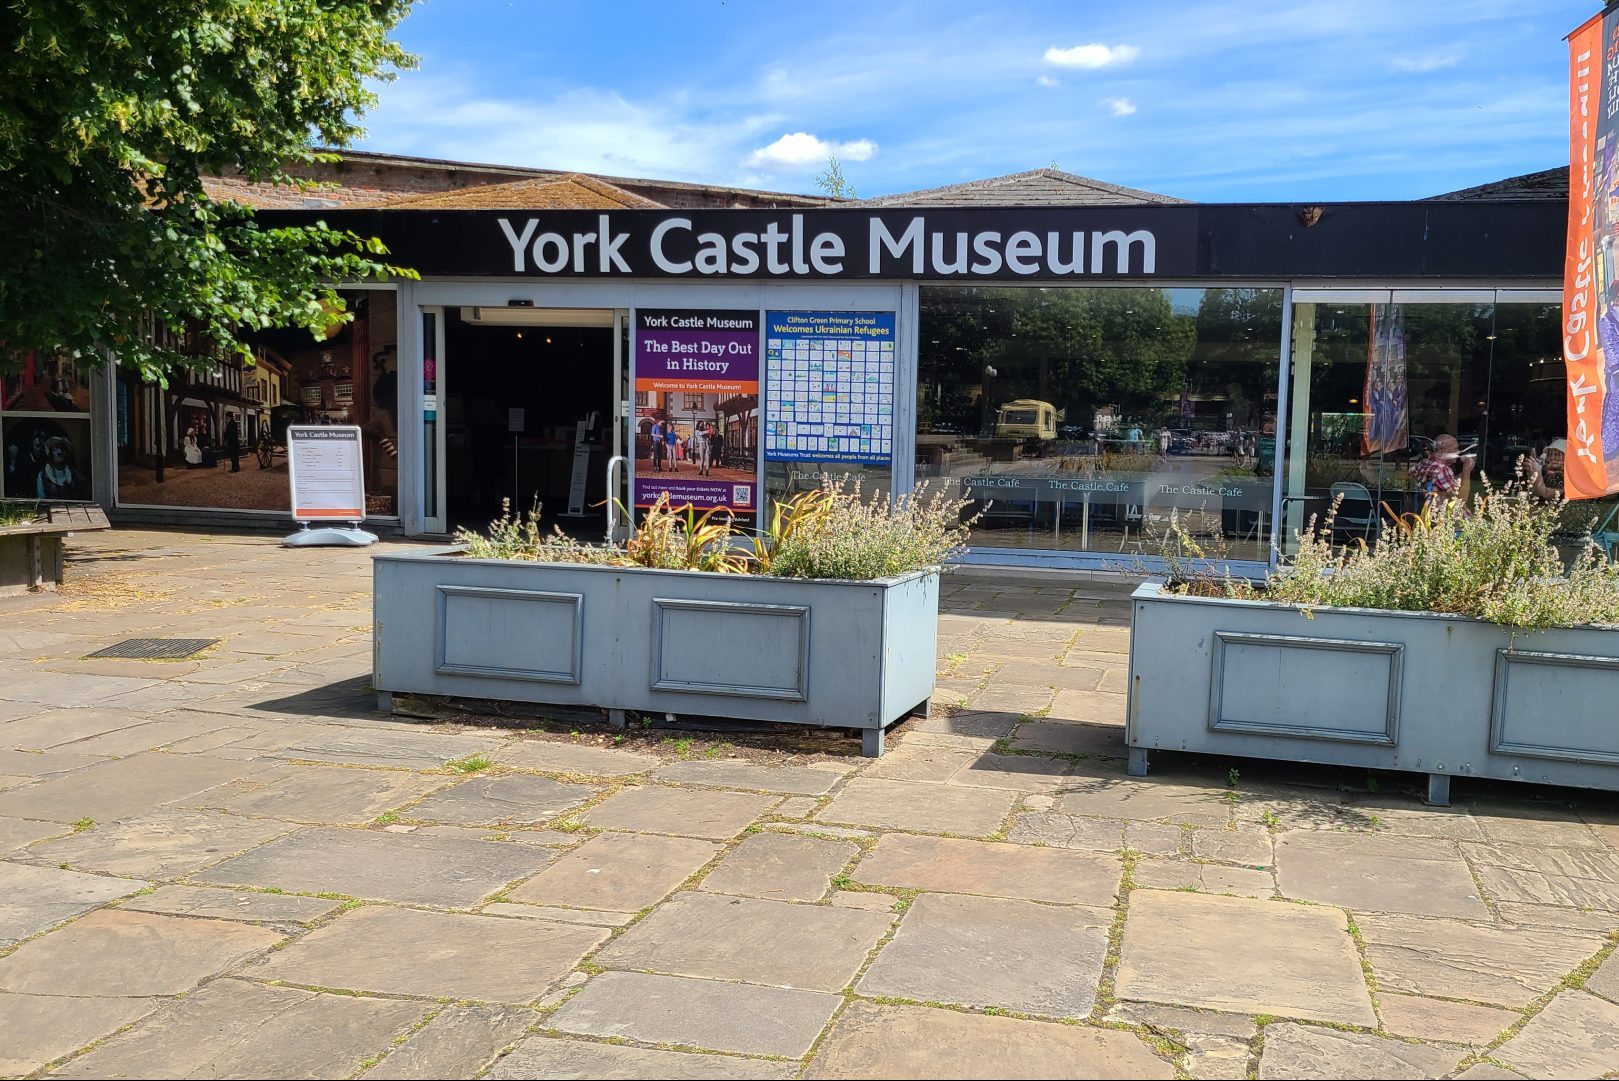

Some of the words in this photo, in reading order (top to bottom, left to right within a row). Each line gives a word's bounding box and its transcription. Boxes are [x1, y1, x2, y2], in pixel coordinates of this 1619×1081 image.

[497, 214, 633, 273] York
[649, 213, 846, 275] Castle
[869, 216, 1156, 275] Museum
[644, 316, 668, 328] York
[670, 316, 704, 328] Castle
[706, 317, 753, 329] Museum
[830, 317, 853, 326] Primary
[774, 324, 814, 333] Welcomes
[815, 325, 852, 334] Ukrainian
[854, 326, 890, 336] Refugees
[644, 340, 668, 352] The
[671, 341, 698, 353] Best
[701, 341, 726, 356] Day
[728, 342, 752, 354] Out
[666, 358, 680, 370] in
[682, 358, 729, 374] History
[792, 470, 809, 480] The
[812, 471, 842, 480] Castle
[942, 476, 960, 486] The
[964, 477, 994, 486] Castle
[998, 479, 1020, 488] Café
[1049, 480, 1067, 489] The
[1071, 481, 1102, 491] Castle
[1106, 483, 1129, 492] Café
[1160, 484, 1179, 494] The
[1182, 486, 1215, 496] Castle
[1218, 487, 1243, 497] Café
